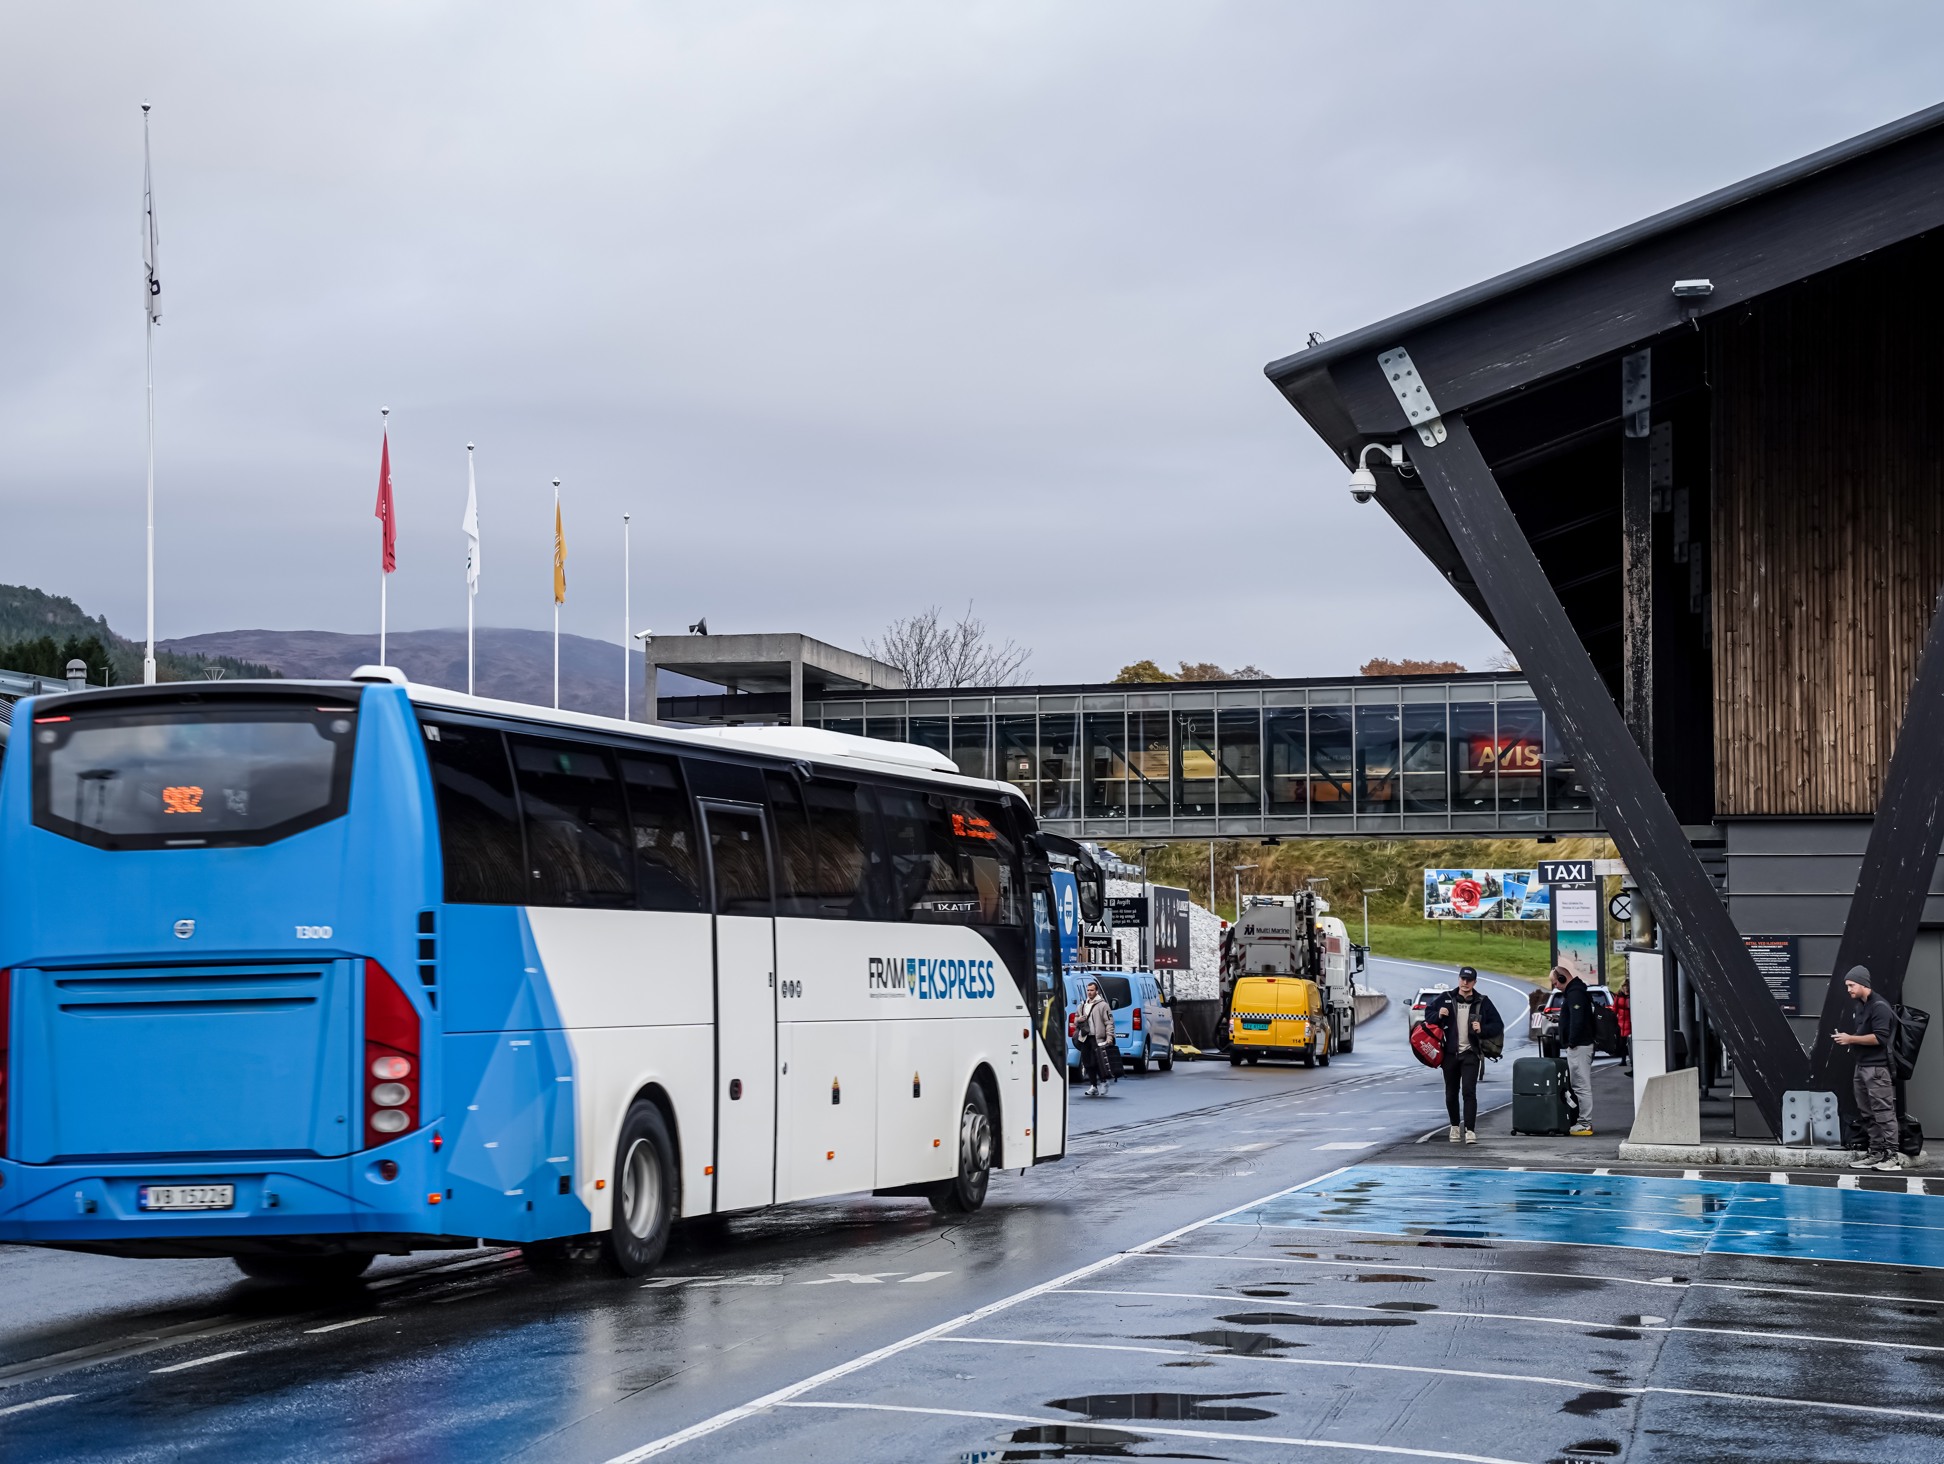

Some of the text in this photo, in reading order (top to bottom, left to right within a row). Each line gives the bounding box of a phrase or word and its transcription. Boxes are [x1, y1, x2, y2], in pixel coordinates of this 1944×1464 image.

[1477, 745, 1540, 767] AVIS
[1544, 864, 1587, 881] TAXI
[294, 925, 333, 939] 1300
[868, 957, 996, 1000] FRAM EKSPRESS
